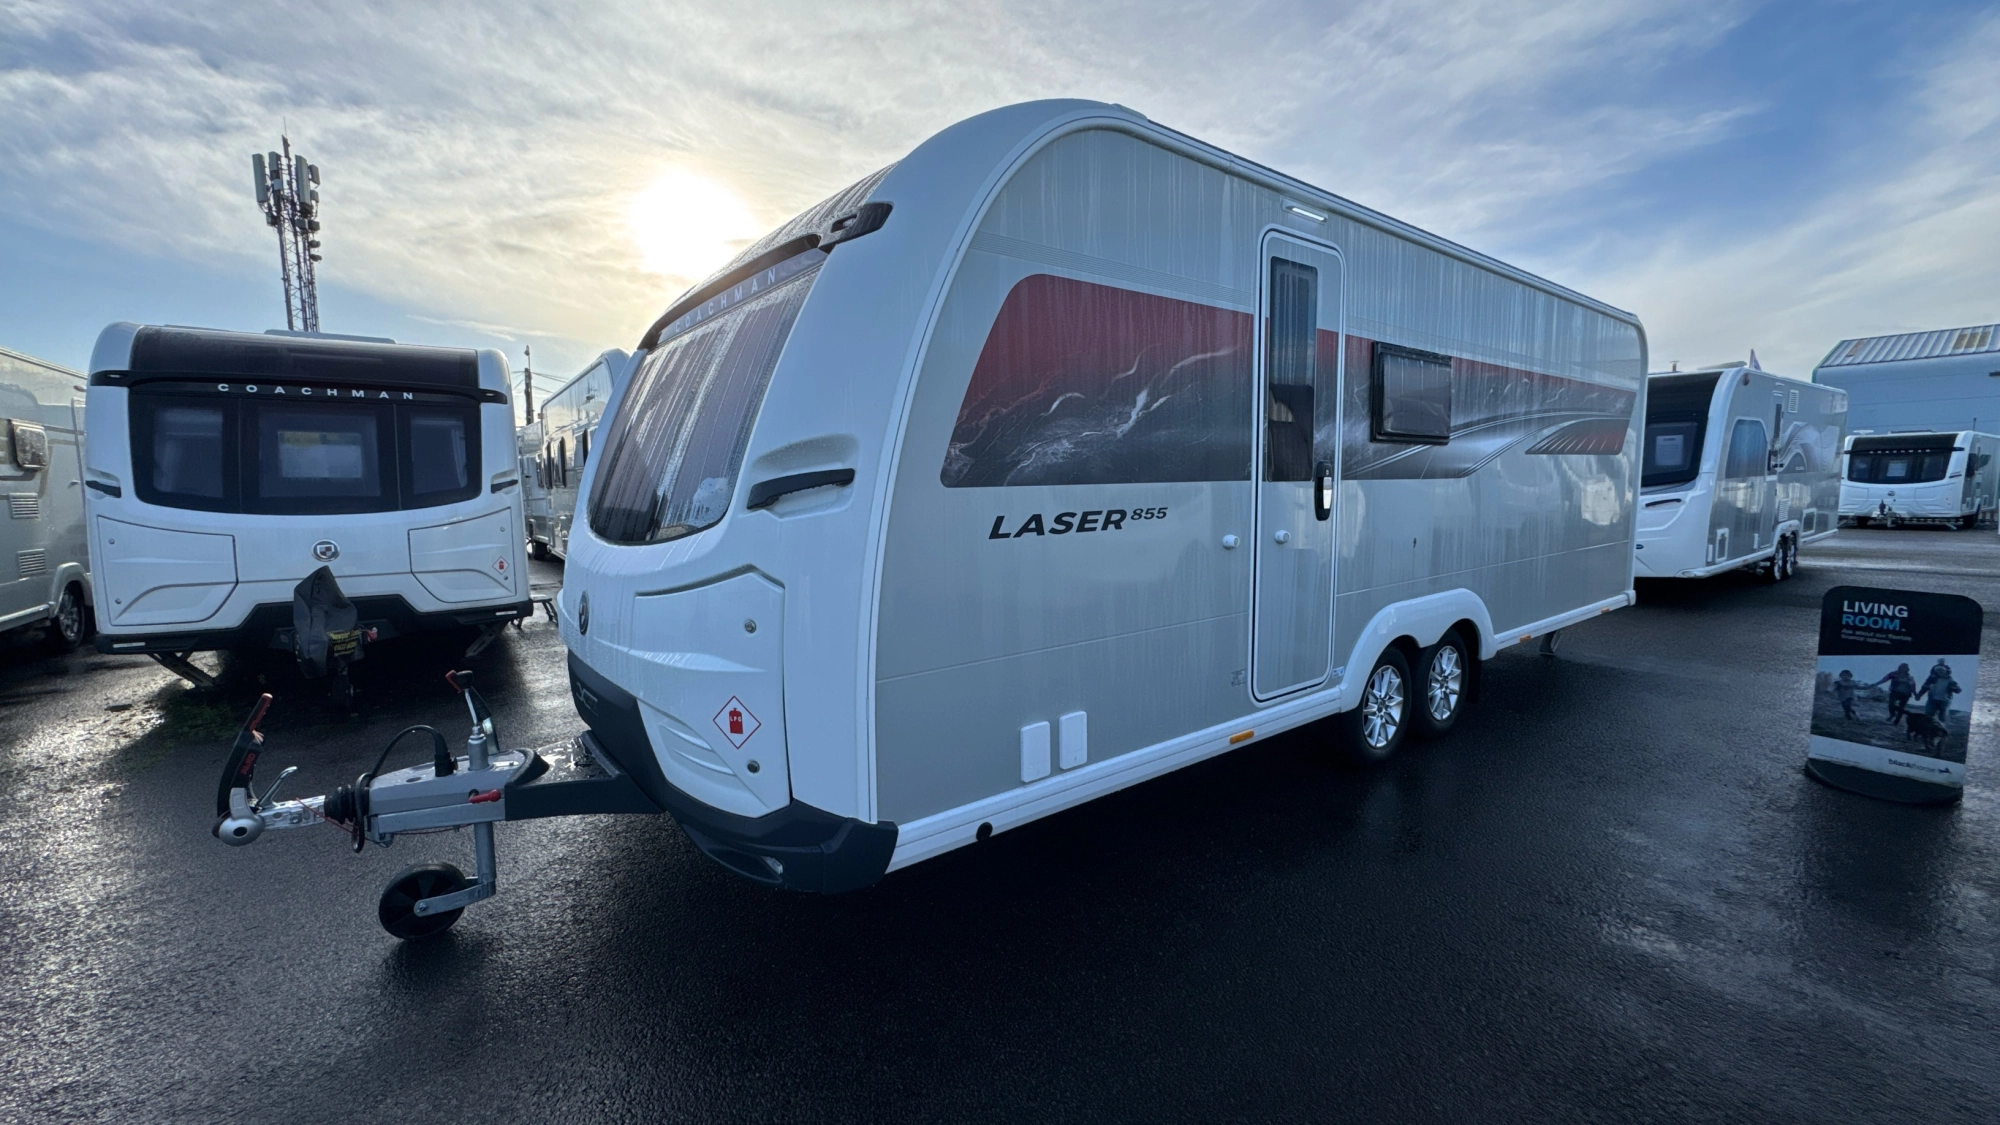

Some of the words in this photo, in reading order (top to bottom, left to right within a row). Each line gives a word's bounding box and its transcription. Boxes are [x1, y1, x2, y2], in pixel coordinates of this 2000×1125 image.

[675, 267, 777, 333] COACHMAN
[217, 383, 414, 400] COACHMAN
[988, 509, 1128, 540] LASER
[1130, 507, 1168, 521] 855
[1843, 600, 1908, 617] LIVING
[730, 715, 742, 723] LPG
